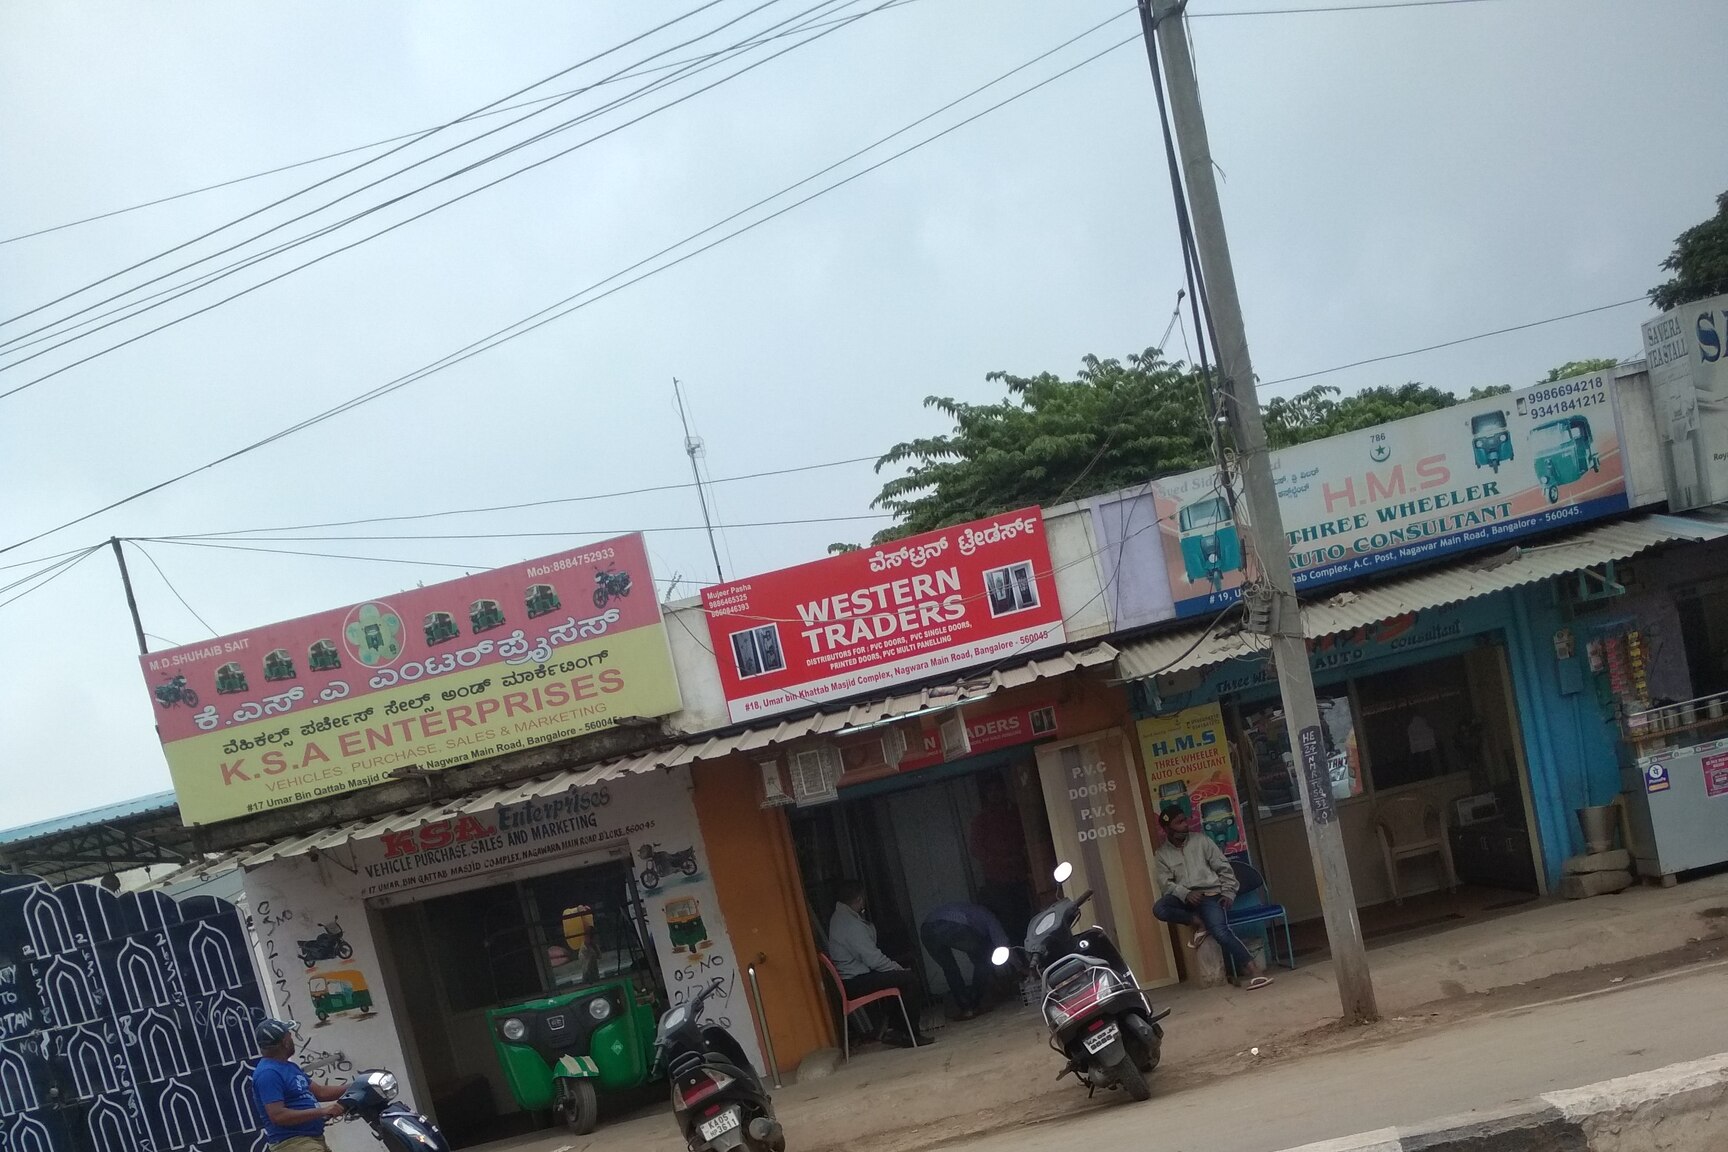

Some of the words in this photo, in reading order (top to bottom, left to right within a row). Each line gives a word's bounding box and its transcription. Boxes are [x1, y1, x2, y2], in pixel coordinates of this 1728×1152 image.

[1528, 376, 1603, 405] 9986694218
[1530, 392, 1606, 420] 9341841212
[1370, 433, 1386, 443] 786
[1322, 453, 1451, 513] H.M.S
[1286, 512, 1368, 546] THREE
[1376, 481, 1500, 523] WHEELER
[1353, 502, 1513, 549] CONSULTANT
[527, 547, 615, 578] Mob:8884752933
[1309, 560, 1352, 581] Complex,
[1374, 550, 1397, 565] Post,
[1399, 540, 1438, 558] Nagawar
[1440, 534, 1462, 547] Main
[1463, 528, 1490, 543] Road,
[1492, 517, 1537, 536] Bangalore
[707, 589, 729, 600] Mujeer
[730, 583, 752, 594] Pasha
[796, 566, 961, 628] WESTERN
[801, 594, 966, 654] TRADERS
[224, 638, 250, 654] SAIT
[806, 649, 852, 667] DISTRIBUTORS
[852, 645, 866, 656] FOR
[870, 640, 882, 651] PVC
[910, 631, 923, 642] PVC
[924, 624, 947, 639] SINGLE
[830, 656, 858, 671] PRINTED
[883, 648, 896, 659] PVC
[896, 642, 917, 656] MULTI
[917, 635, 952, 652] PANELLING
[1315, 649, 1363, 669] AUTO
[744, 699, 762, 712] #18,
[763, 693, 784, 708] Umar
[785, 688, 798, 702] bin
[799, 682, 830, 699] Khattab
[831, 674, 856, 692] Masjid
[857, 667, 894, 685] Complex,
[894, 659, 929, 677] Nagwara
[930, 653, 950, 667] Main
[951, 647, 974, 662] Road,
[974, 638, 1014, 658] Bangalore
[1019, 630, 1049, 647] 560045
[219, 741, 330, 786] K.S.A
[338, 668, 625, 758] ENTERPRISES
[446, 729, 496, 750] SALES
[514, 702, 608, 734] MARKETING
[967, 716, 1020, 738] ADERS
[1152, 730, 1217, 757] H.M.S
[1155, 756, 1181, 770] THREE
[1181, 748, 1219, 763] WHEELER
[246, 800, 264, 813] #17
[266, 793, 293, 810] Umar
[295, 788, 312, 803] Bin
[313, 780, 347, 800] Qattab
[348, 773, 380, 795] Masjid
[426, 751, 469, 771] Nagwara
[471, 744, 494, 760] Main
[496, 737, 525, 755] Road,
[527, 726, 577, 750] Bangalore
[1072, 760, 1107, 779] P.V.C
[1151, 770, 1172, 781] AUTO
[1175, 756, 1226, 775] CONSULTANT
[1069, 780, 1117, 800] DOORS
[1080, 803, 1116, 820] P.V.C
[365, 856, 413, 879] VEHICLE
[471, 834, 504, 855] SALES
[507, 829, 528, 848] AND
[531, 812, 598, 841] MARKETING
[1078, 822, 1126, 842] DOORS
[418, 869, 448, 885] QATTAB
[562, 838, 579, 850] MAIN
